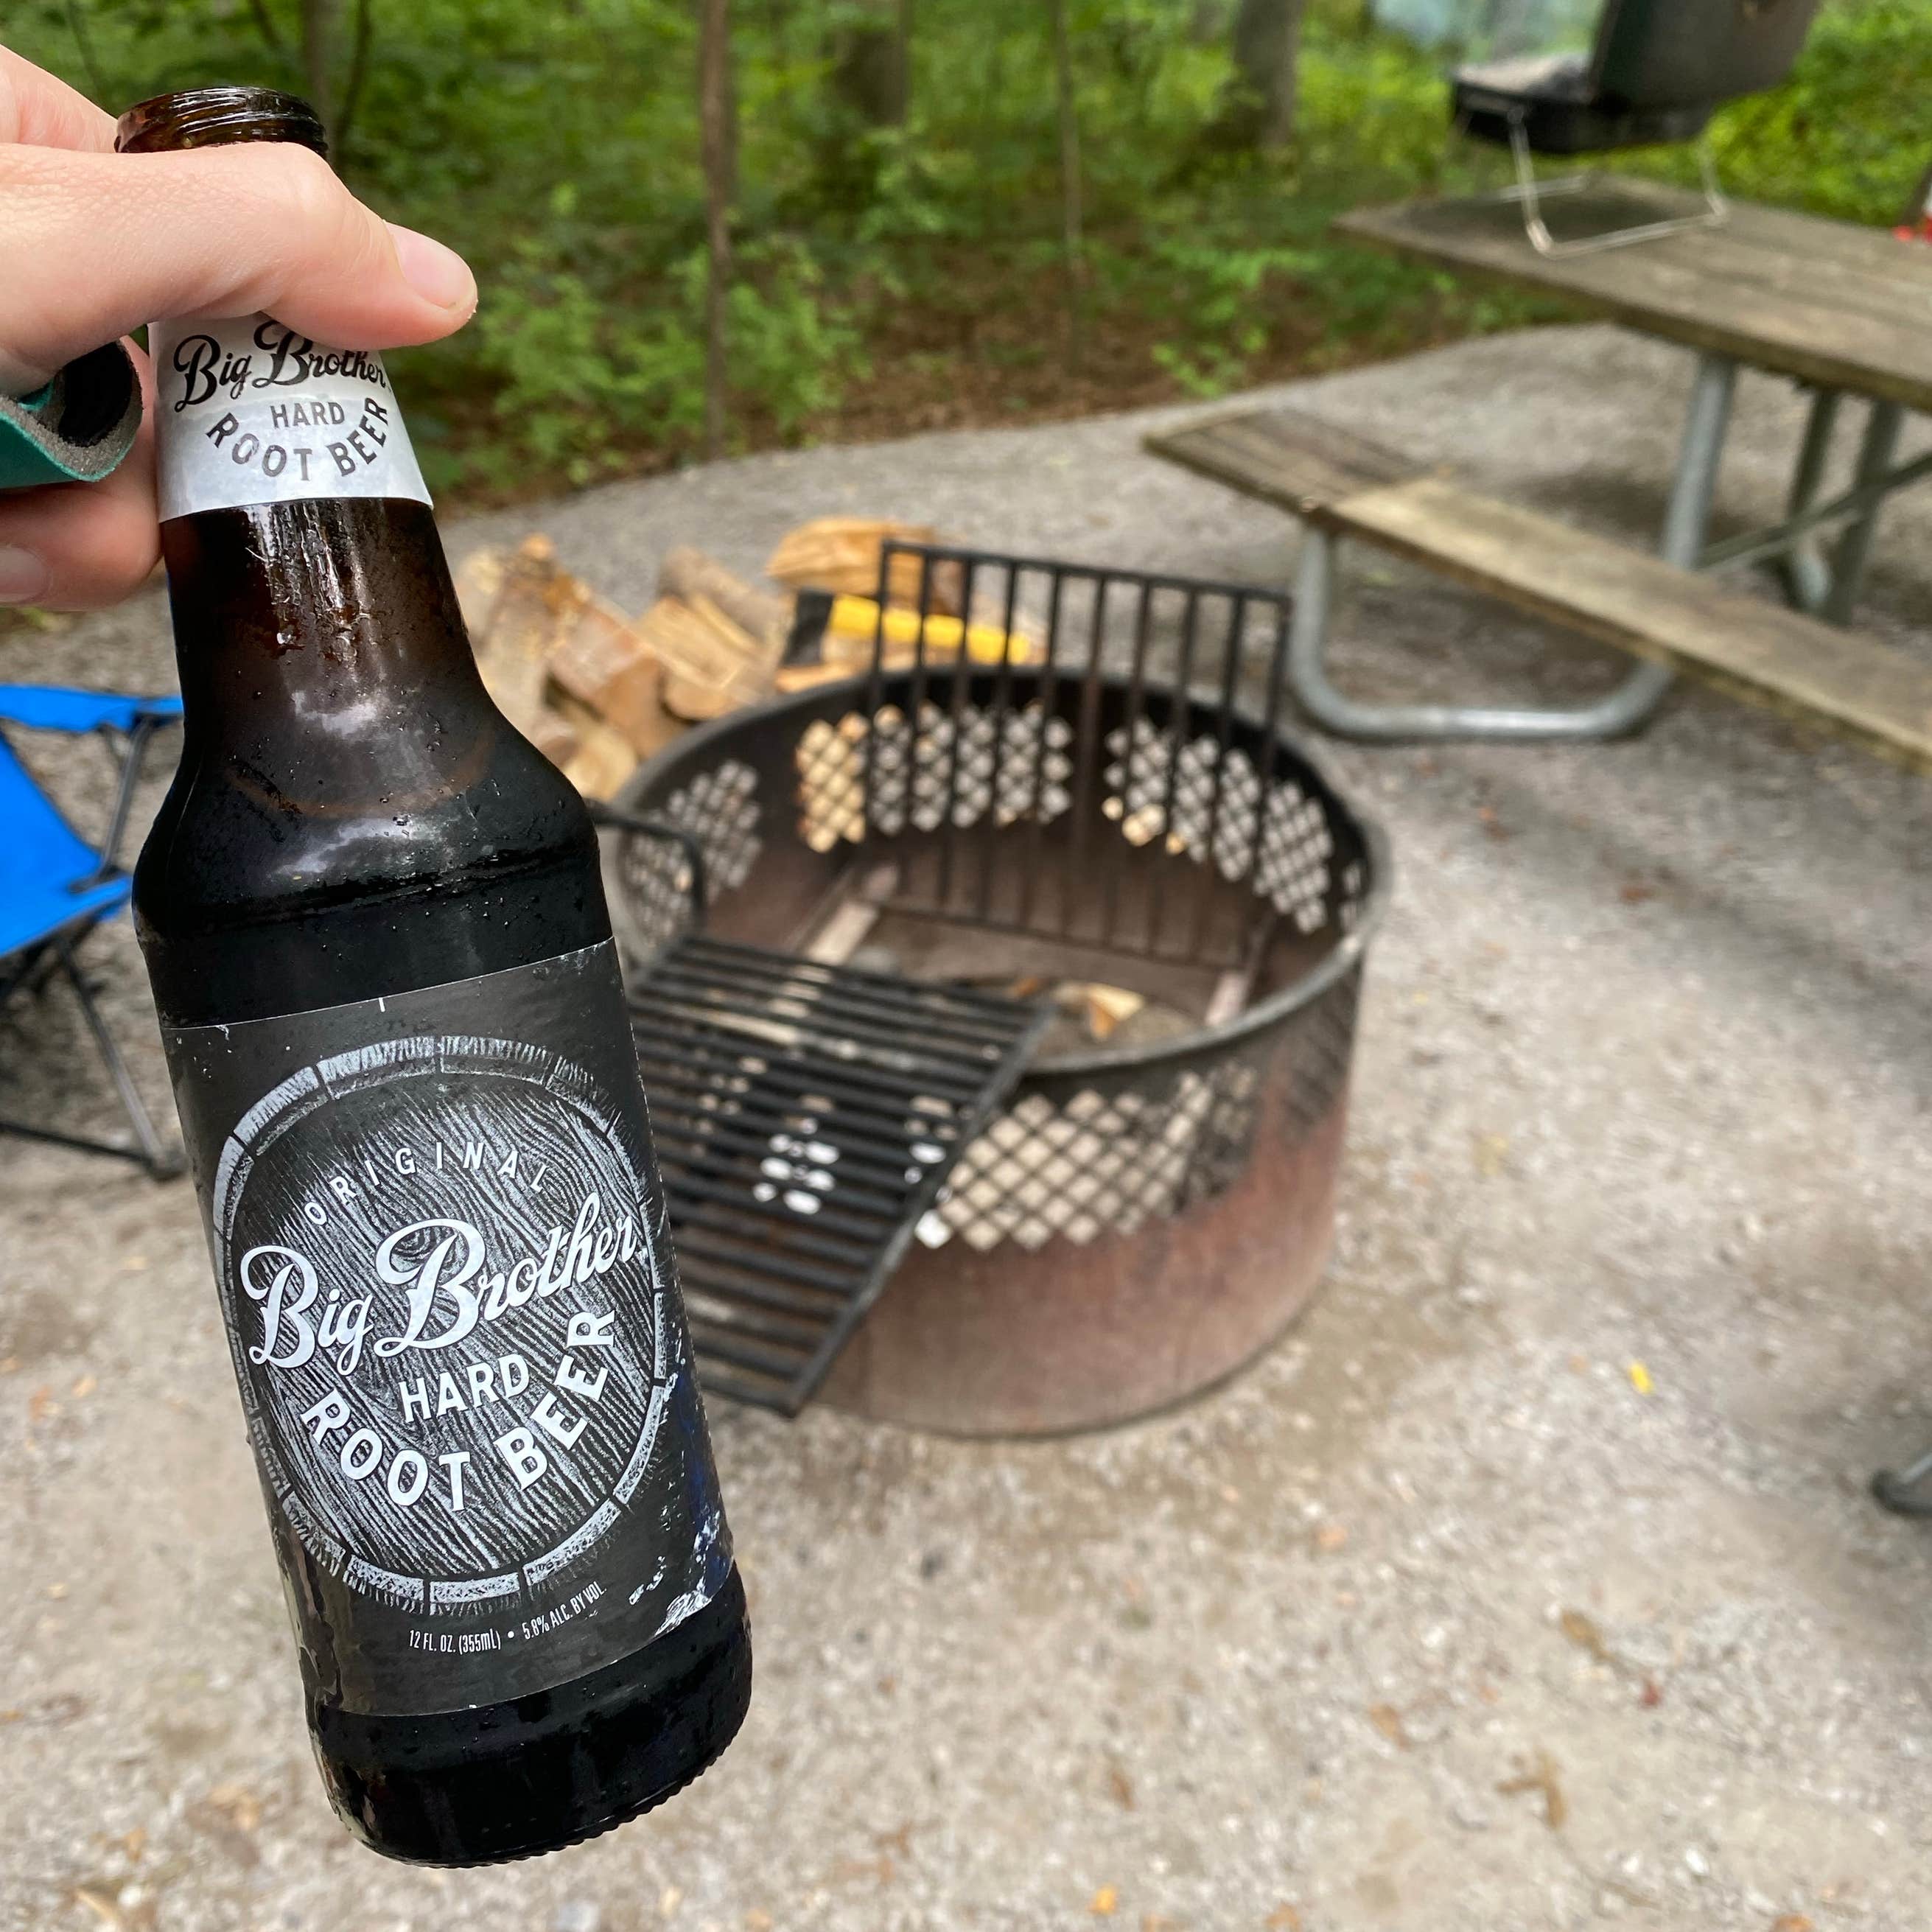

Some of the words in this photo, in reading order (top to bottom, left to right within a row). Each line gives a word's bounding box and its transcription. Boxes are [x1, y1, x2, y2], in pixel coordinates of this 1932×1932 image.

[173, 335, 252, 413] Big
[252, 320, 386, 389] Brother
[206, 412, 313, 481] ROOT
[326, 397, 389, 477] BEER
[270, 402, 346, 429] HARD
[304, 1141, 550, 1225] ORIGINAL
[239, 1245, 374, 1376] Big
[374, 1192, 637, 1358] Brother
[300, 1388, 471, 1512] ROOT
[494, 1309, 616, 1491] BEER
[398, 1354, 531, 1424] HARD
[409, 1629, 420, 1648] 12
[423, 1632, 437, 1652] FL.
[440, 1634, 456, 1653] OZ.
[522, 1614, 550, 1640] 5.8%
[550, 1604, 573, 1628] ALC.
[570, 1594, 587, 1615] BY
[584, 1580, 607, 1603] VOL.
